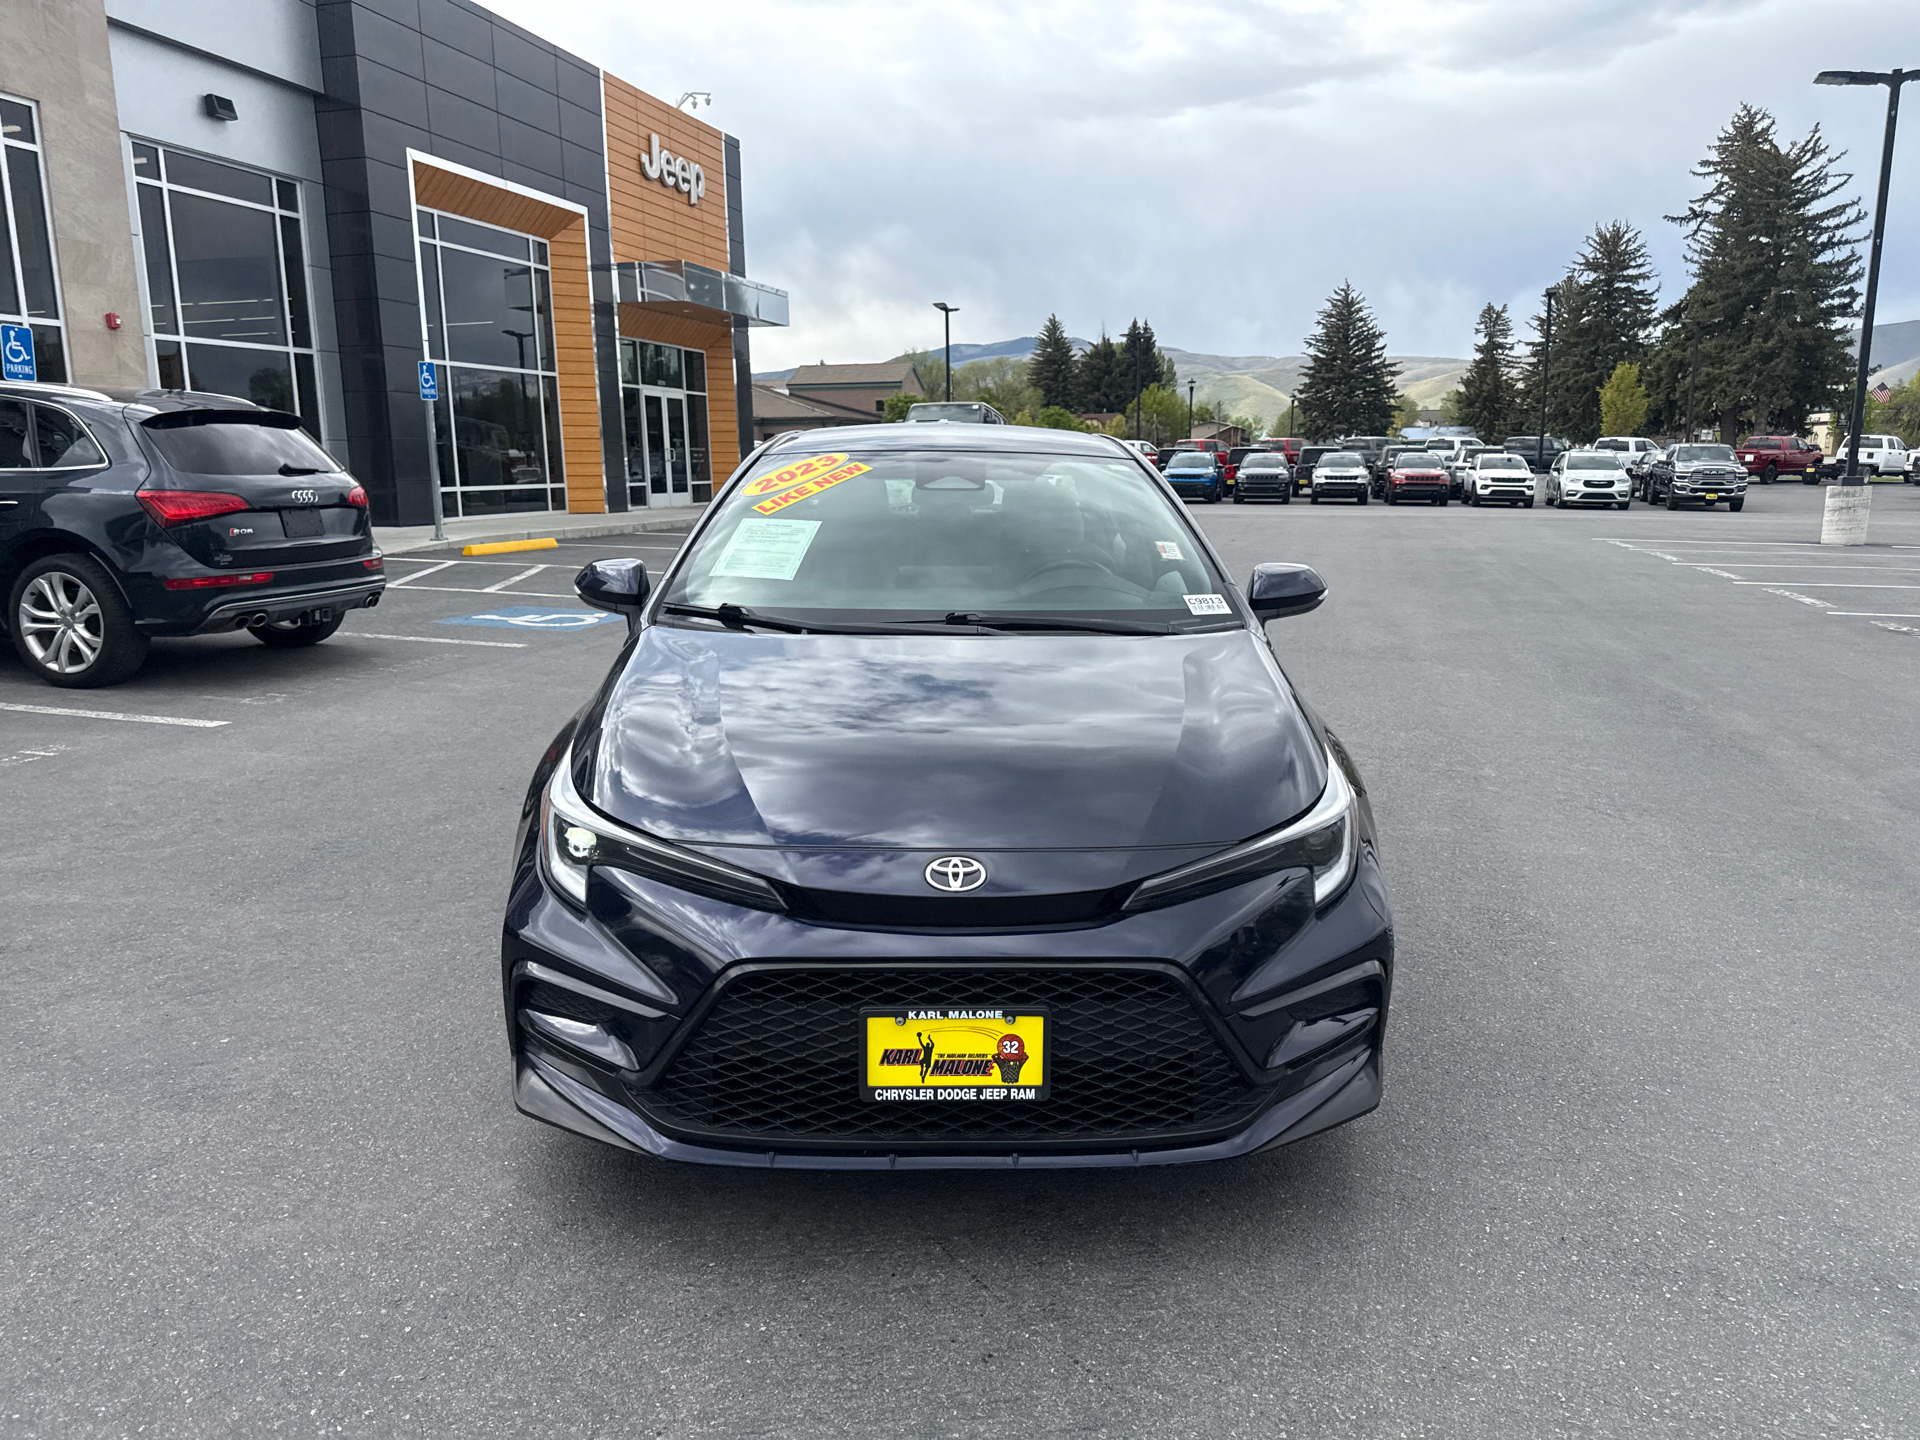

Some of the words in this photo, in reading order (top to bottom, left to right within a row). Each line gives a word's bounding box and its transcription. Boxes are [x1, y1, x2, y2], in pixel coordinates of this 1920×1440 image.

[640, 133, 705, 206] Jeep
[6, 363, 33, 375] PARKING
[755, 455, 840, 492] 2023
[757, 486, 813, 513] LIKE
[812, 463, 865, 488] NEW
[1187, 597, 1223, 605] C9813
[908, 1010, 944, 1020] KARL
[948, 1010, 1003, 1020] MALONE
[1002, 1040, 1019, 1054] 32
[879, 1048, 923, 1066] KARL
[929, 1059, 995, 1077] MALONE
[875, 1088, 934, 1101] CHRYSLER
[937, 1088, 977, 1100] DODGE
[979, 1088, 1007, 1100] JEEP
[1010, 1088, 1036, 1100] RAM
